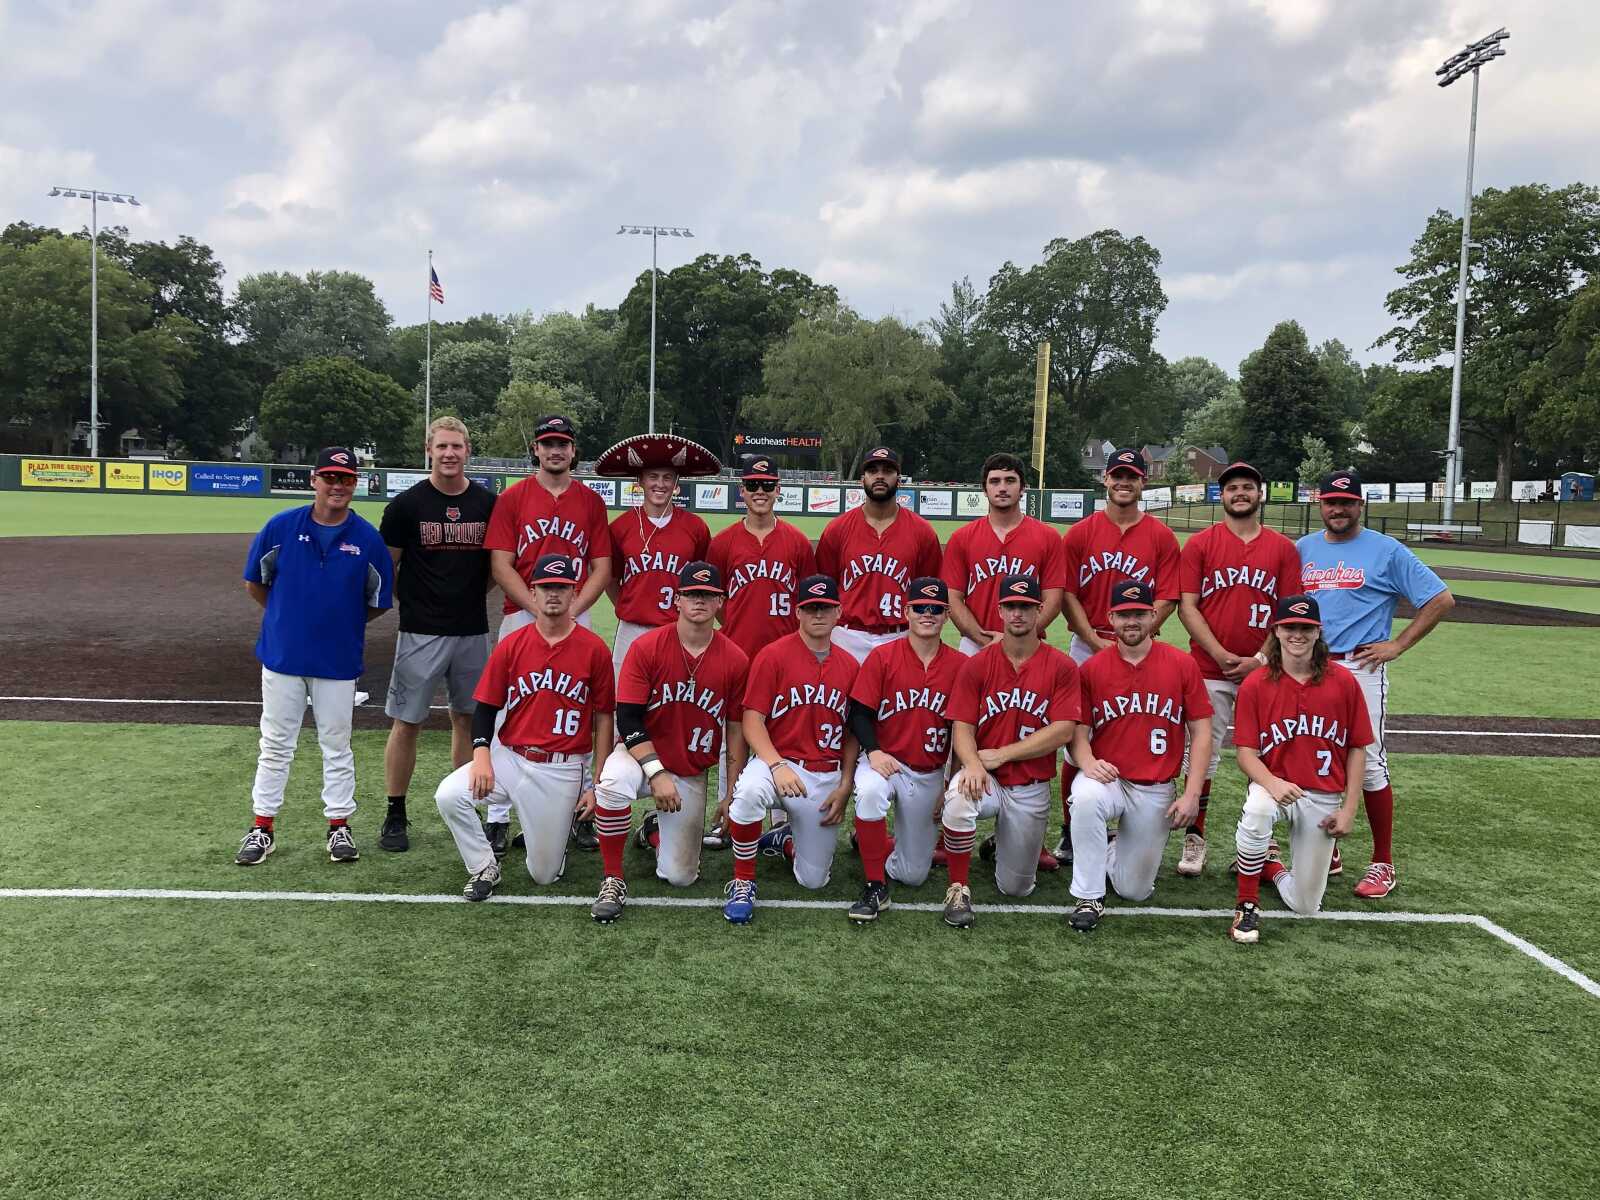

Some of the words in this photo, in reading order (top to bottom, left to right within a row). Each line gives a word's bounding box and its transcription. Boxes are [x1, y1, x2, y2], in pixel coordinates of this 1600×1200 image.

[745, 435, 822, 447] SoutheastHEALTH
[420, 521, 441, 545] RED
[619, 550, 691, 587] CAPAH
[967, 554, 1040, 596] CAPAHA
[658, 586, 675, 611] 3
[768, 592, 791, 617] 15
[1248, 603, 1272, 629] 17
[770, 684, 849, 720] CAPAHA
[877, 687, 947, 721] CAPAH
[551, 708, 581, 736] 16
[687, 727, 715, 753] 14
[818, 723, 844, 750] 32
[924, 727, 949, 753] 33
[1151, 728, 1168, 755] 6
[1316, 750, 1333, 776] 7
